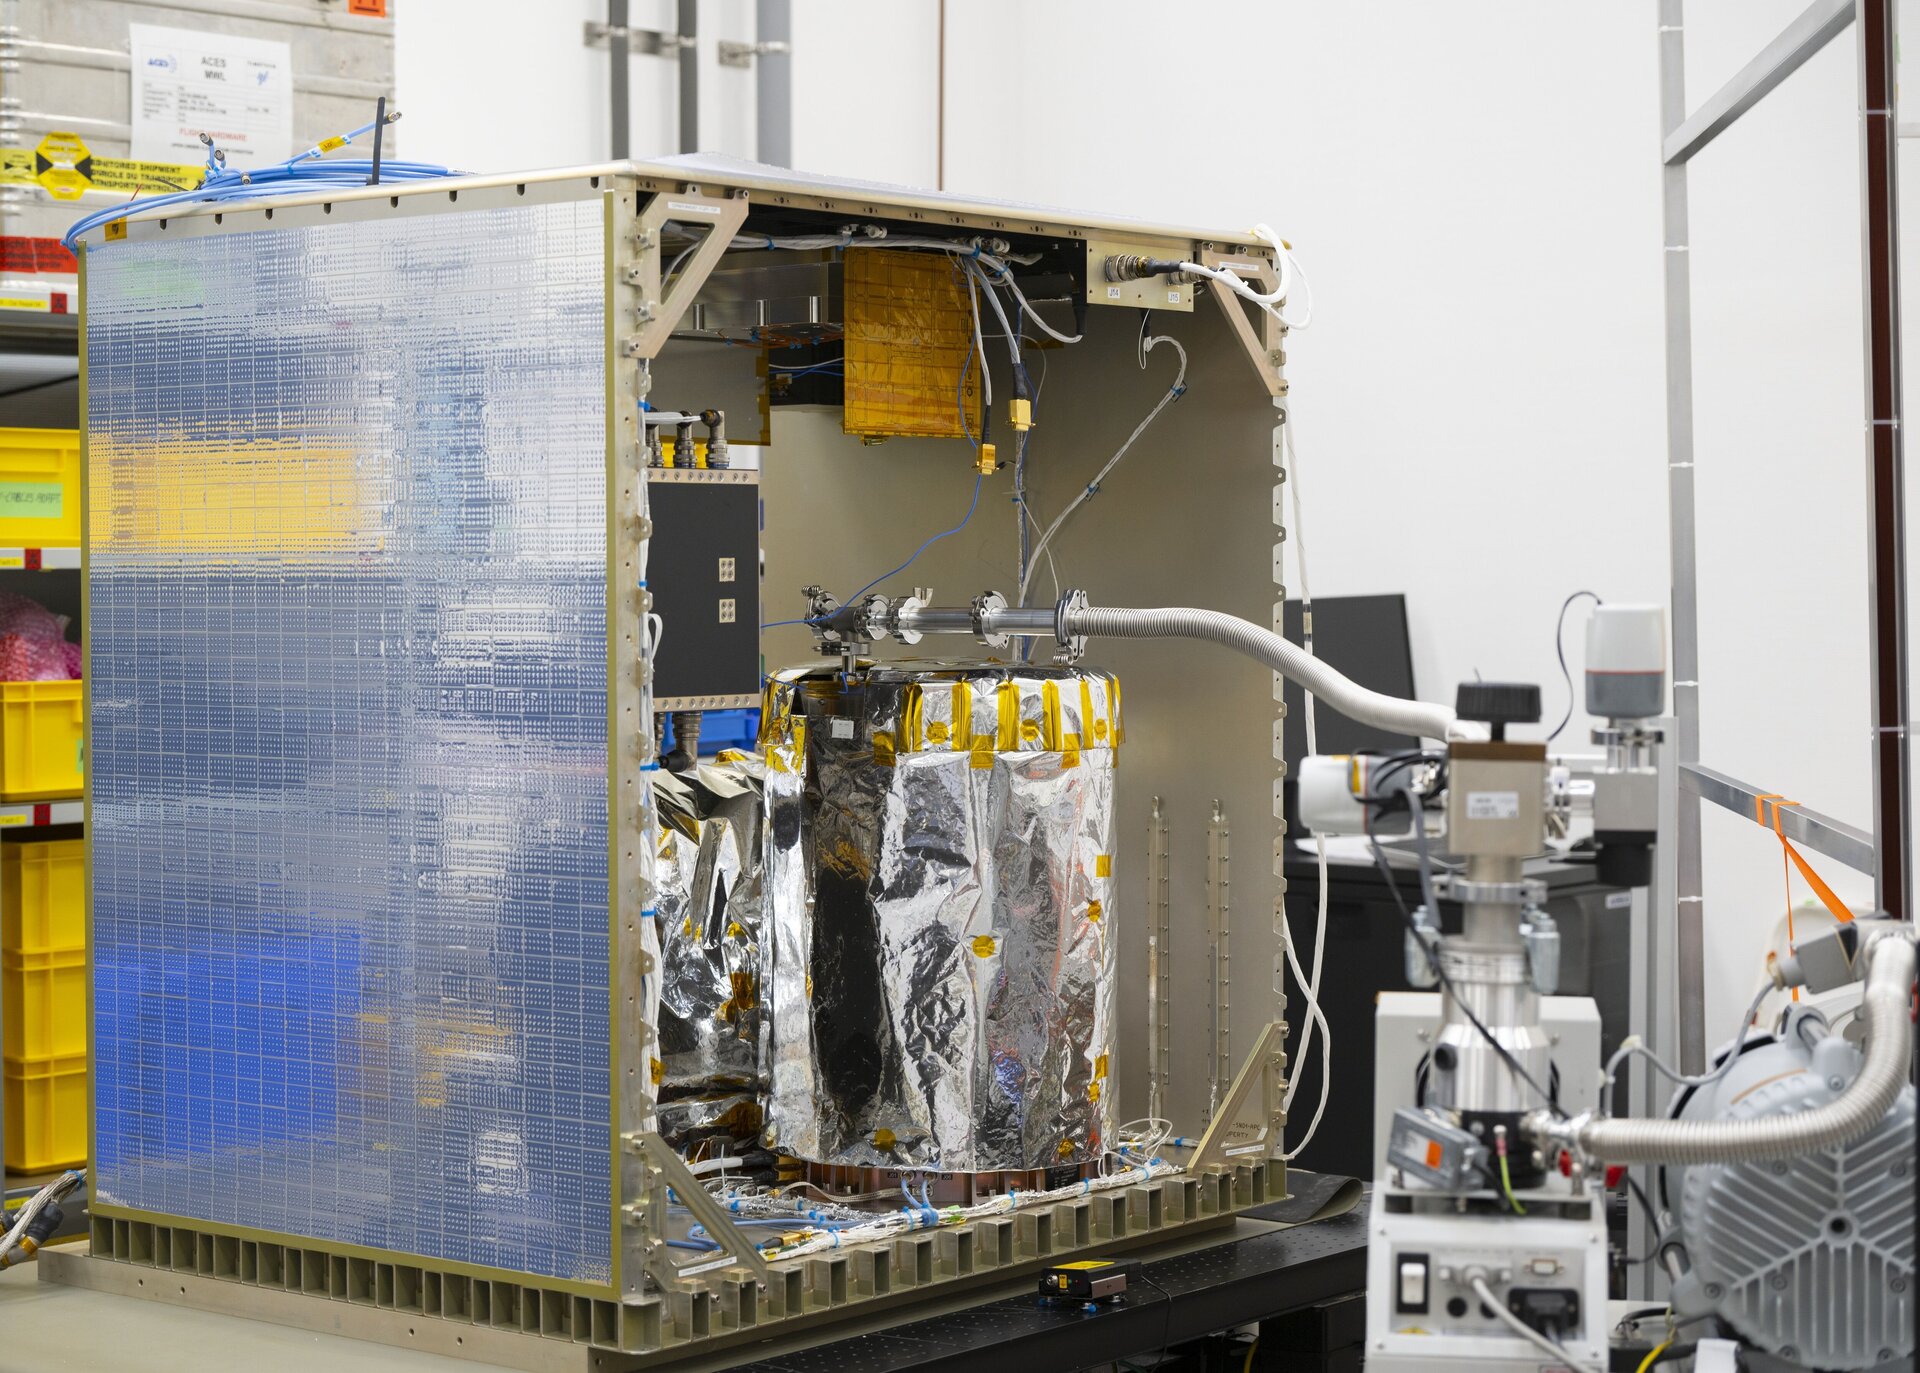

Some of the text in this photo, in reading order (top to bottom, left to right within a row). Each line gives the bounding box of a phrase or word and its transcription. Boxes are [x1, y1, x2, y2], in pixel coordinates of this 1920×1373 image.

[201, 57, 226, 68] ACES
[180, 128, 205, 138] FLIGH
[1109, 288, 1119, 297] J14
[1169, 293, 1179, 302] J15
